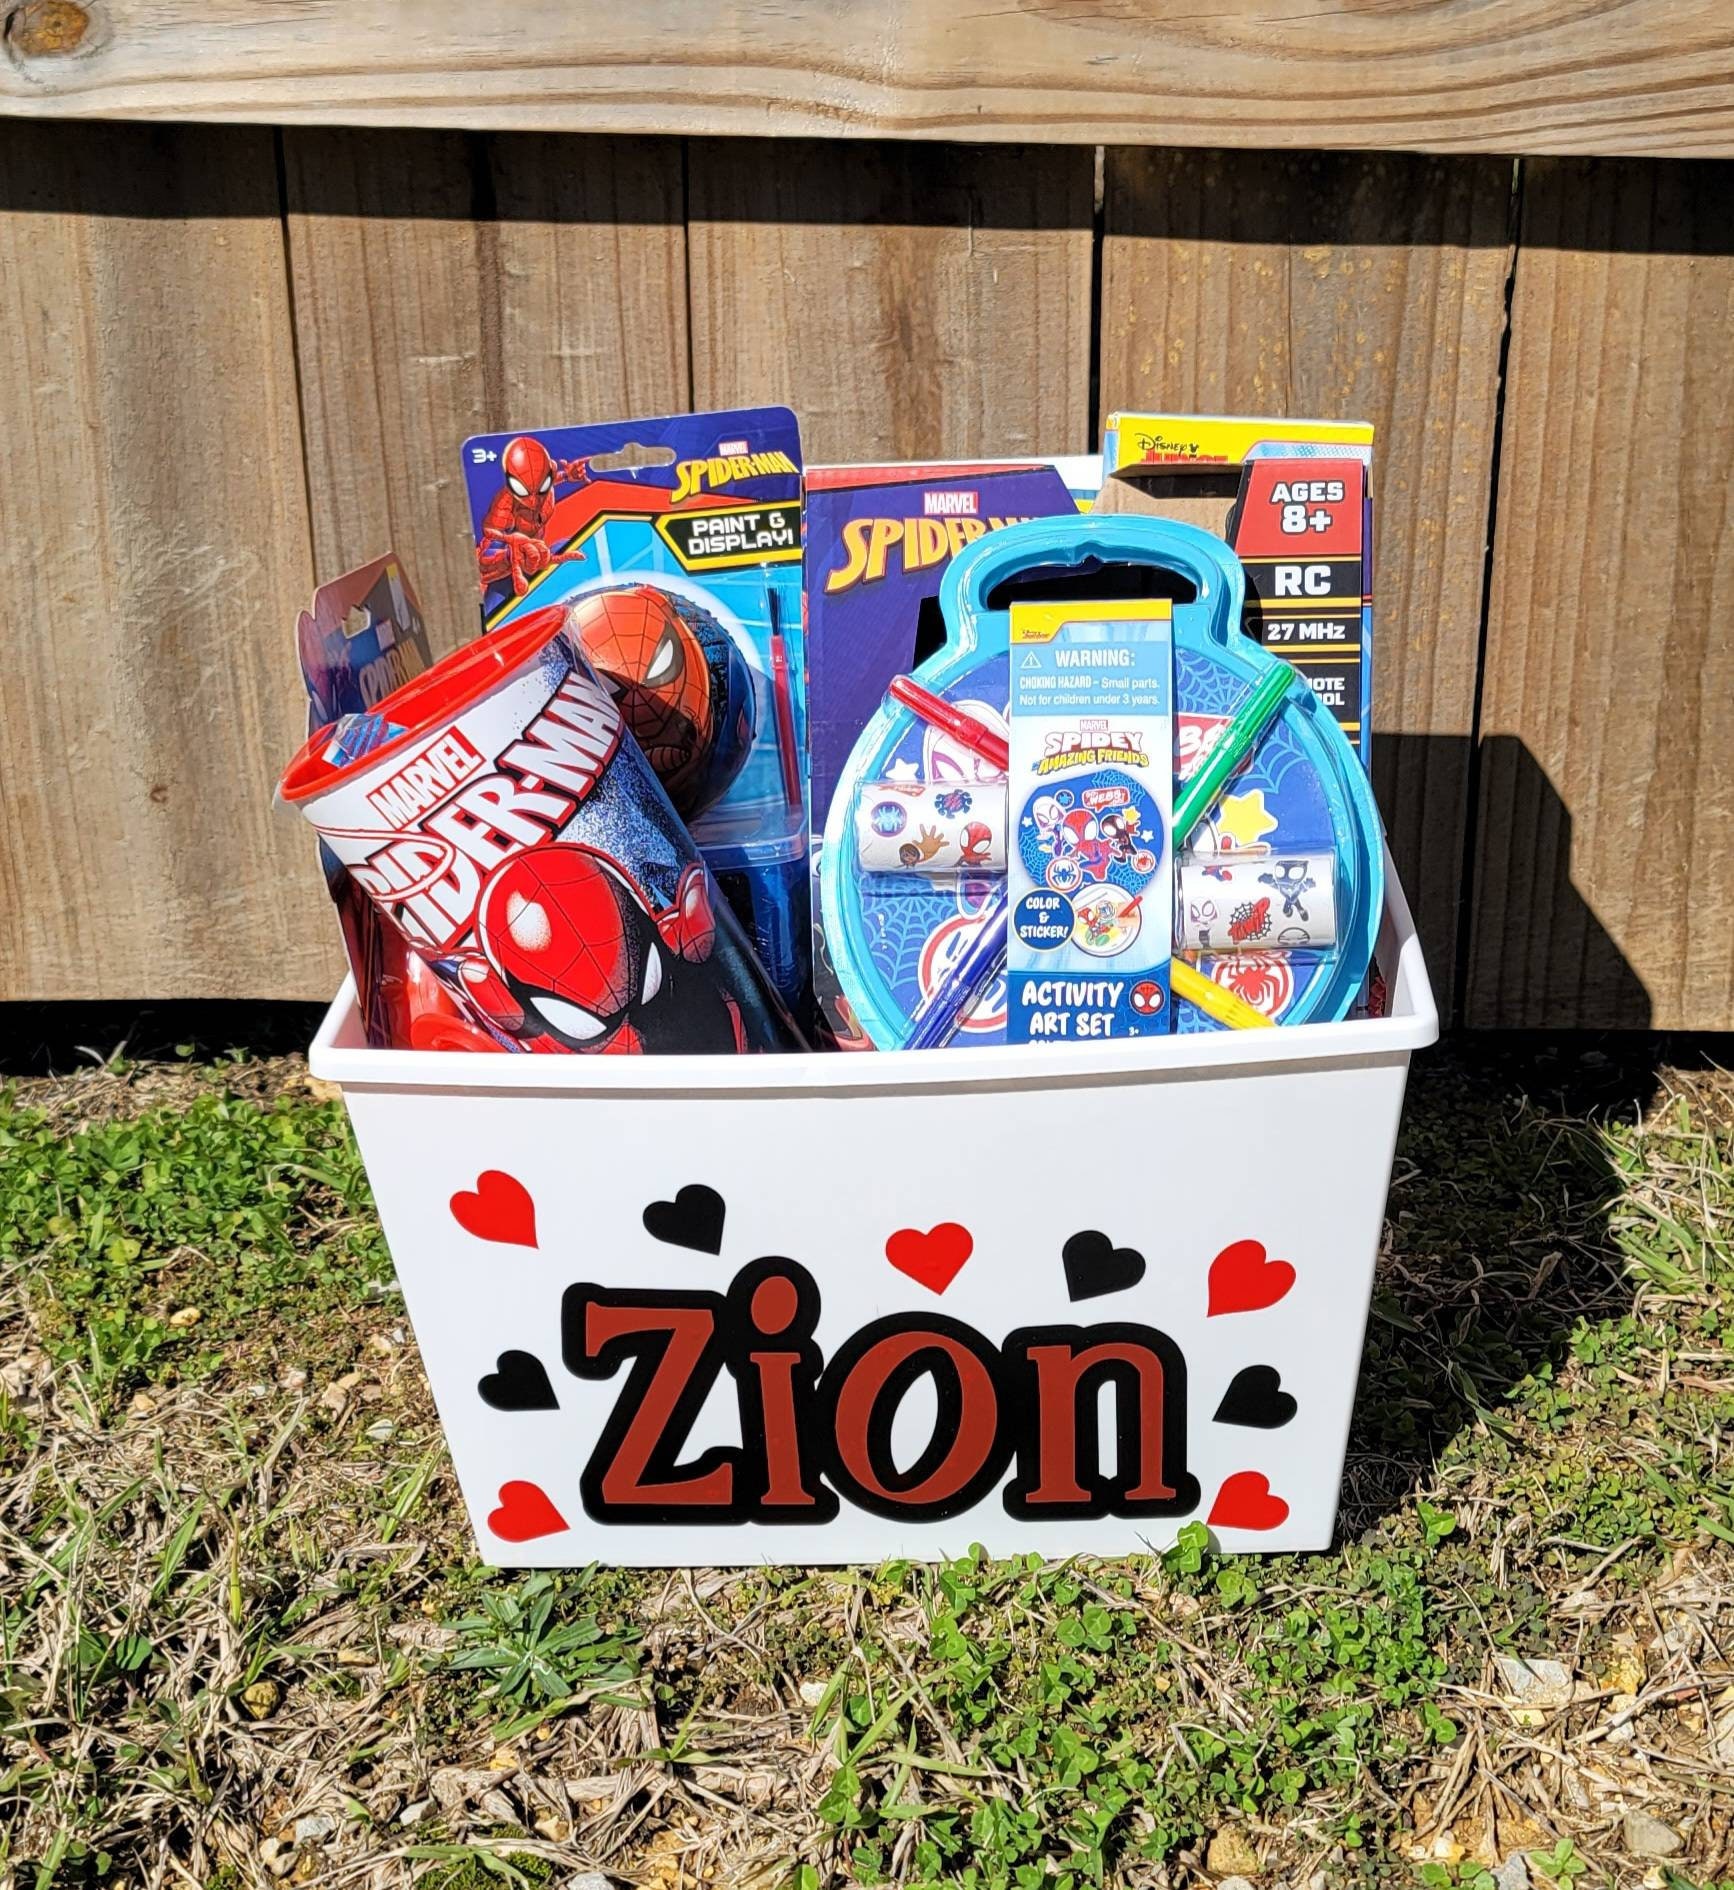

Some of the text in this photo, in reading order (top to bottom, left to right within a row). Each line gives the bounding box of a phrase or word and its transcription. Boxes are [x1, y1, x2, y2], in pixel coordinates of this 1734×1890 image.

[472, 448, 497, 464] 3+
[670, 451, 799, 503] SPIDER-MAN
[924, 491, 977, 515] MARVEL
[1271, 481, 1345, 503] AGES
[692, 515, 760, 537] PAINT
[1281, 504, 1333, 534] 8+
[688, 529, 794, 555] DISPLAY!
[1274, 565, 1331, 597] RC
[1267, 622, 1346, 641] 27 MHz
[1055, 648, 1136, 668] WARNING:
[1019, 675, 1056, 690] CHOKING
[1058, 675, 1092, 689] HAZARD
[1101, 677, 1129, 689] Small
[1131, 677, 1161, 690] parts.
[1307, 677, 1346, 691] OTE
[1019, 692, 1160, 707] Not for children under 3 years.
[1080, 720, 1109, 732] MARVEL
[1044, 731, 1144, 757] SPIDEY
[1036, 749, 1097, 776] AMAZING
[1097, 748, 1150, 768] FRIENDS
[369, 732, 482, 829] MARVEL
[1025, 896, 1061, 911] COLOR
[1038, 911, 1050, 924] &
[1020, 925, 1069, 939] STICKER!
[1021, 980, 1125, 1008] ACTIVITY
[1029, 1011, 1115, 1037] ART SET
[580, 1271, 1182, 1510] Zion
